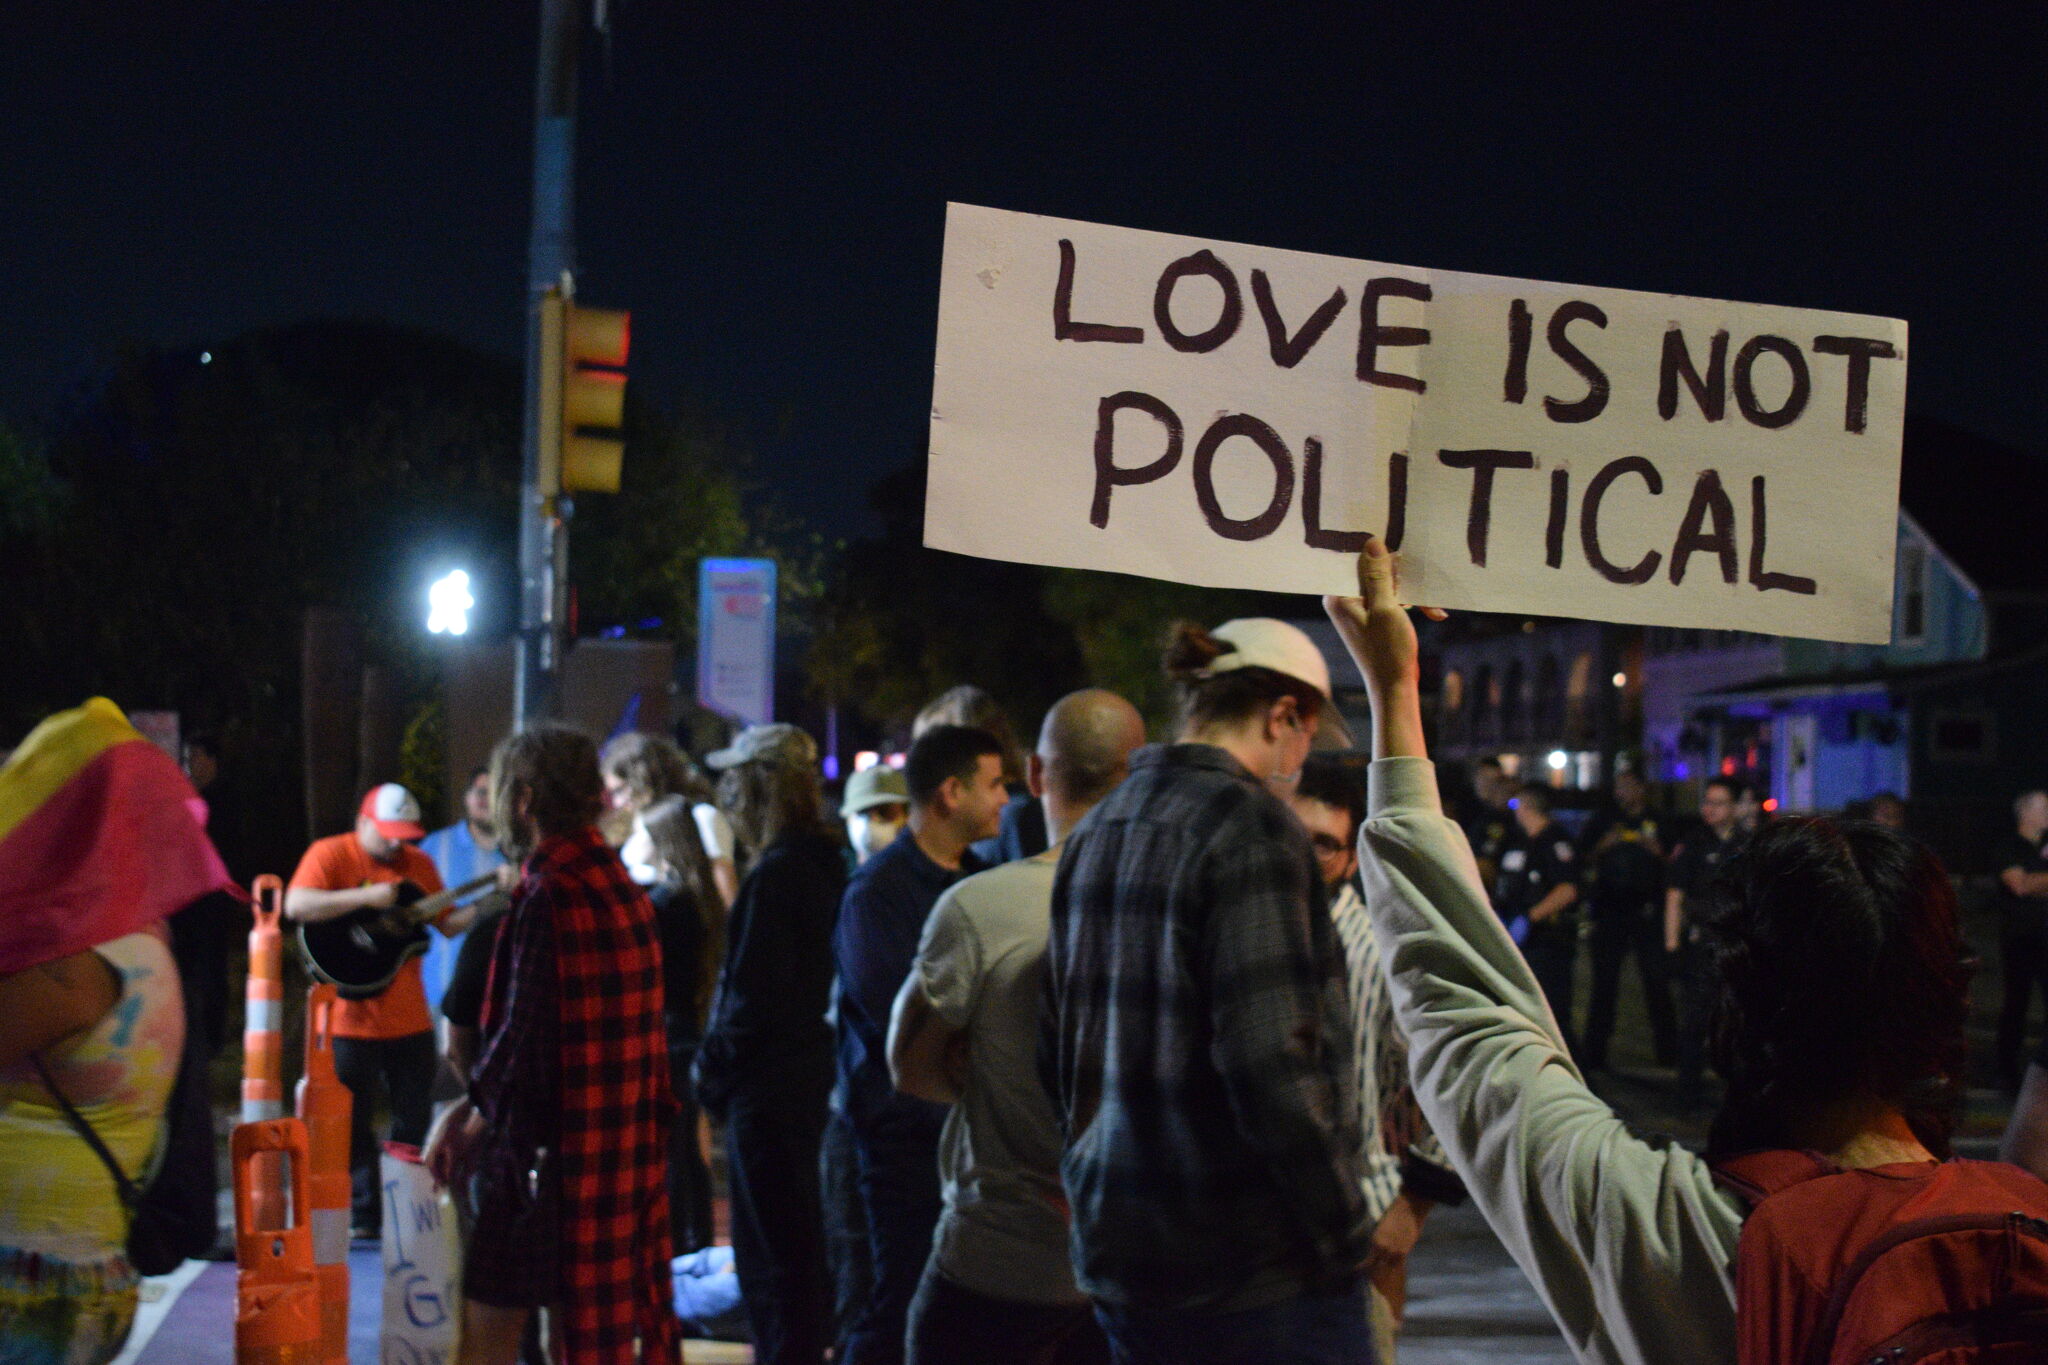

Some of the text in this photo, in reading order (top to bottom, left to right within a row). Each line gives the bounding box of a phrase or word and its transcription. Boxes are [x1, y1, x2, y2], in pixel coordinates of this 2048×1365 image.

[1053, 238, 1904, 434] LOVE IS NOT
[1089, 390, 1818, 596] POLITICAL
